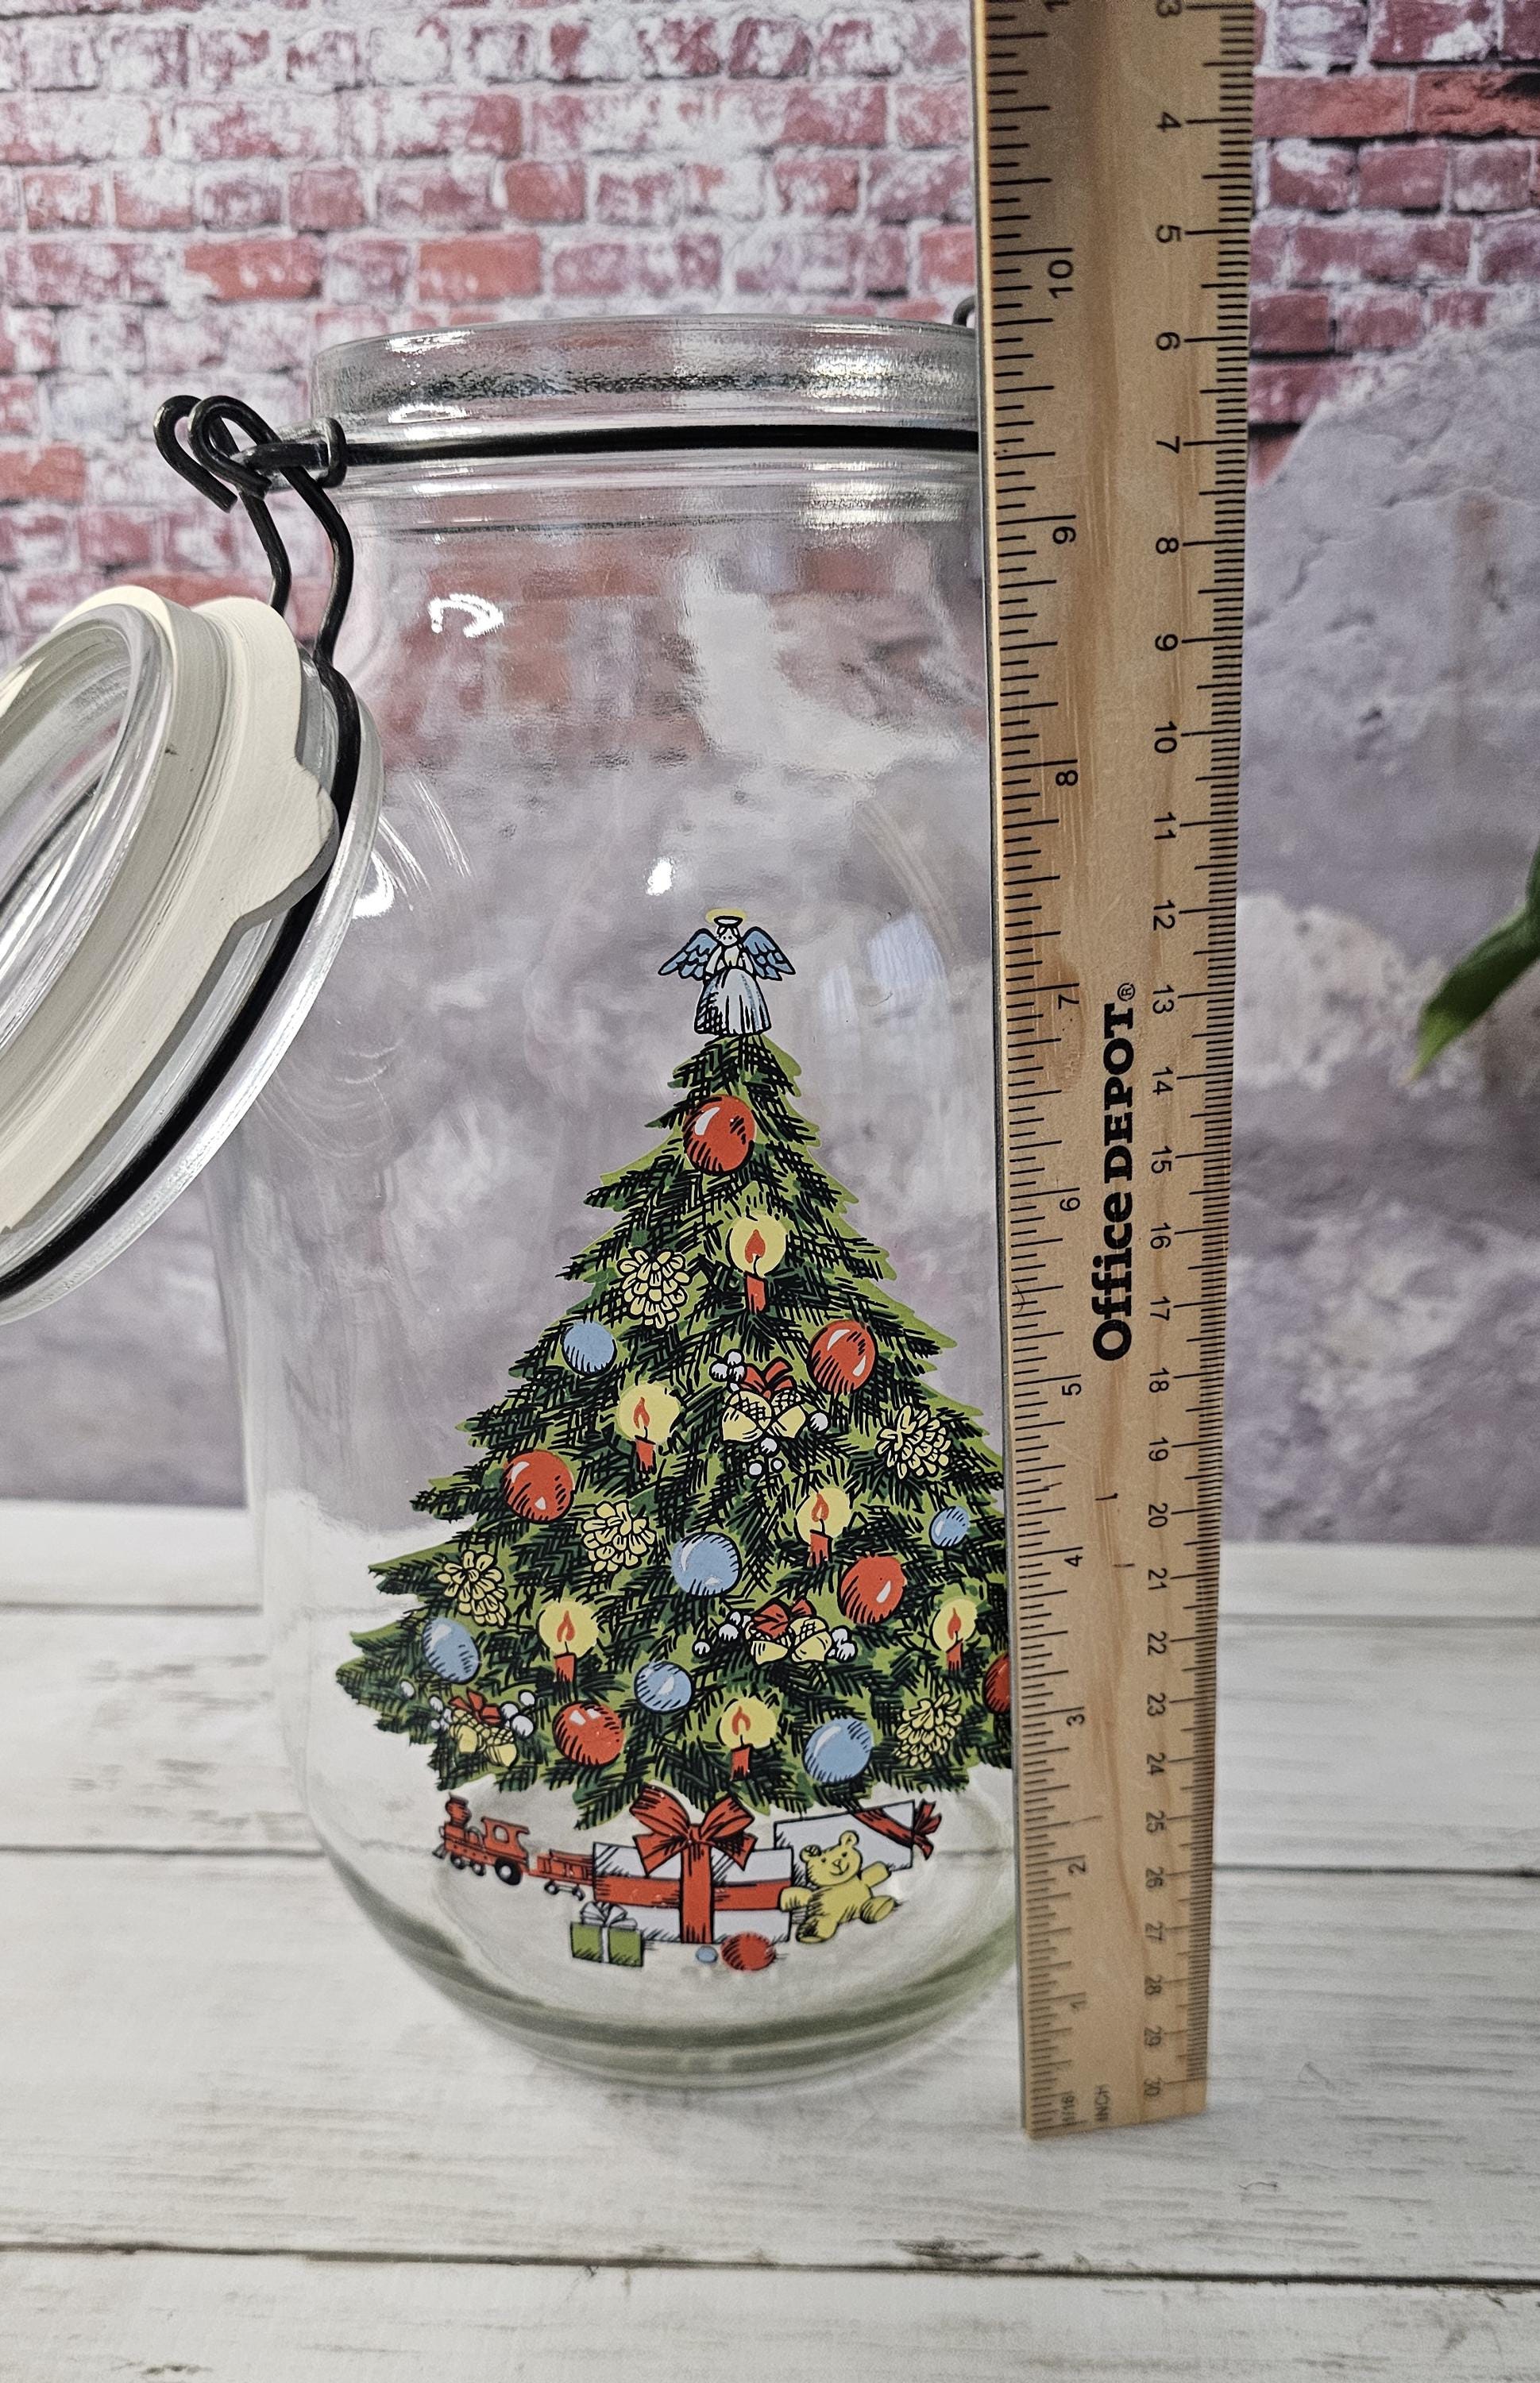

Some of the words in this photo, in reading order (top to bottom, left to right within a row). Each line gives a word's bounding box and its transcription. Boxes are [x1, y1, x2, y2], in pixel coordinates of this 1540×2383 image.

[1156, 0, 1182, 18] 3
[1156, 111, 1182, 133] 4
[1156, 225, 1182, 244] 5
[1048, 259, 1074, 299] 10
[1156, 331, 1182, 351] 6
[1156, 436, 1180, 454] 7
[1052, 526, 1077, 545] 9
[1155, 537, 1179, 554] 8
[1154, 634, 1179, 651] 9
[1153, 720, 1178, 753] 10
[1055, 769, 1079, 786] 8
[1154, 812, 1176, 840] 11
[1152, 899, 1175, 931] 12
[1058, 994, 1080, 1010] 7
[1152, 984, 1175, 1015] 13
[1152, 1066, 1174, 1095] 14
[1150, 1145, 1173, 1175] 15
[1059, 1196, 1080, 1211] 6
[1149, 1222, 1171, 1250] 16
[1149, 1296, 1171, 1322] 17
[1061, 1382, 1082, 1397] 5
[1148, 1367, 1171, 1393] 18
[1148, 1437, 1169, 1462] 19
[1148, 1502, 1168, 1528] 20
[1063, 1554, 1083, 1567] 4
[1148, 1568, 1168, 1590] 21
[1147, 1631, 1167, 1655] 22
[1146, 1692, 1167, 1717] 23
[1066, 1713, 1085, 1727] 3
[1146, 1752, 1165, 1776] 24
[1145, 1809, 1165, 1833] 25
[1067, 1860, 1086, 1875] 2
[1145, 1867, 1164, 1890] 26
[1144, 1921, 1164, 1941] 27
[1144, 1975, 1163, 1995] 28
[1071, 1999, 1087, 2013] 1
[1144, 2026, 1162, 2047] 29
[1144, 2076, 1162, 2098] 30
